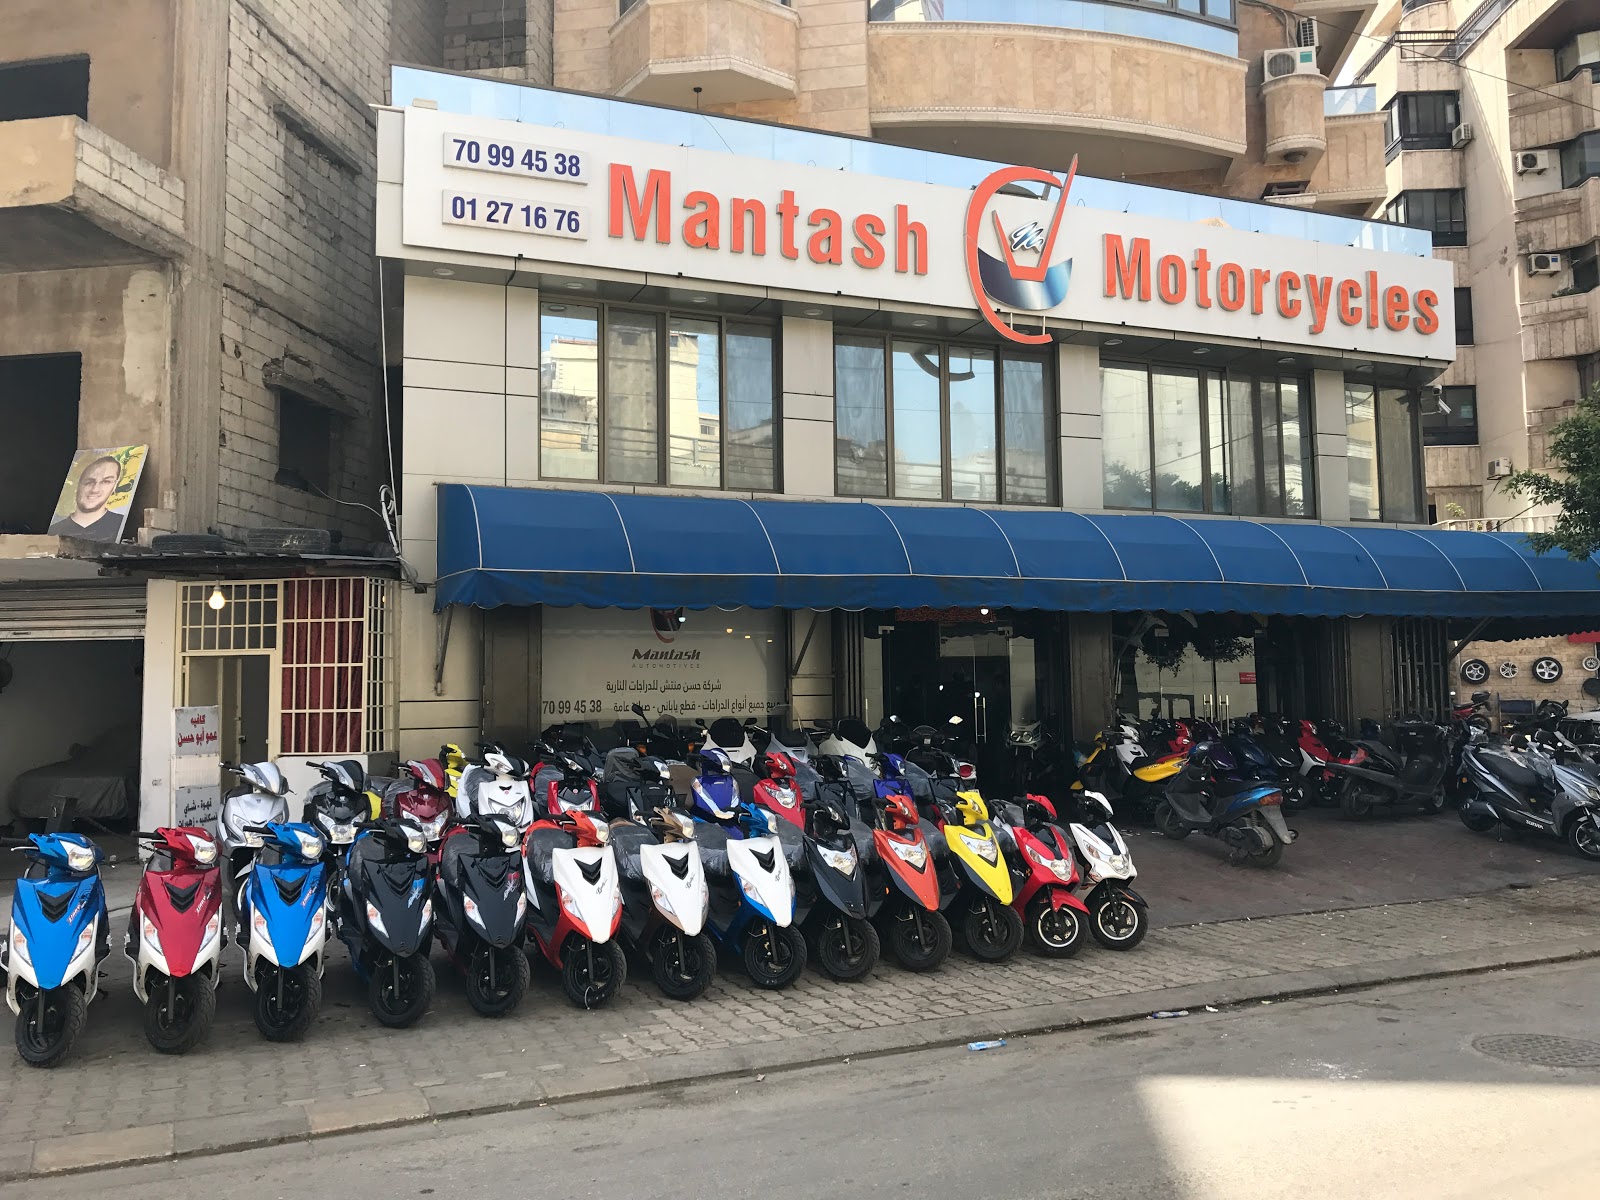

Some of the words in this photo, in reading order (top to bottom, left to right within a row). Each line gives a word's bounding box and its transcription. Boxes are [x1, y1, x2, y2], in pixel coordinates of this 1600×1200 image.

[452, 138, 480, 164] 70
[487, 143, 514, 168] 99
[520, 148, 548, 173] 45
[554, 152, 581, 177] 38
[451, 195, 477, 221] 01
[486, 200, 514, 224] 27
[520, 204, 547, 229] 16
[553, 208, 580, 233] 76
[607, 162, 928, 275] Mantash
[1102, 233, 1440, 336] Motorcycles
[632, 648, 701, 660] Mantash
[606, 680, 627, 694] النارية
[628, 680, 659, 694] للدراجات
[683, 682, 701, 693] حسن
[702, 679, 722, 693] شركة
[542, 700, 555, 715] 70
[558, 700, 571, 714] 99
[573, 700, 587, 714] 45
[589, 699, 602, 713] 38
[613, 701, 630, 712] عامة
[679, 700, 696, 715] قطع
[702, 698, 730, 713] الدراجات
[731, 695, 747, 714] أنواع
[748, 701, 765, 714] جميع
[177, 733, 194, 746] حسن
[206, 730, 217, 744] عمو
